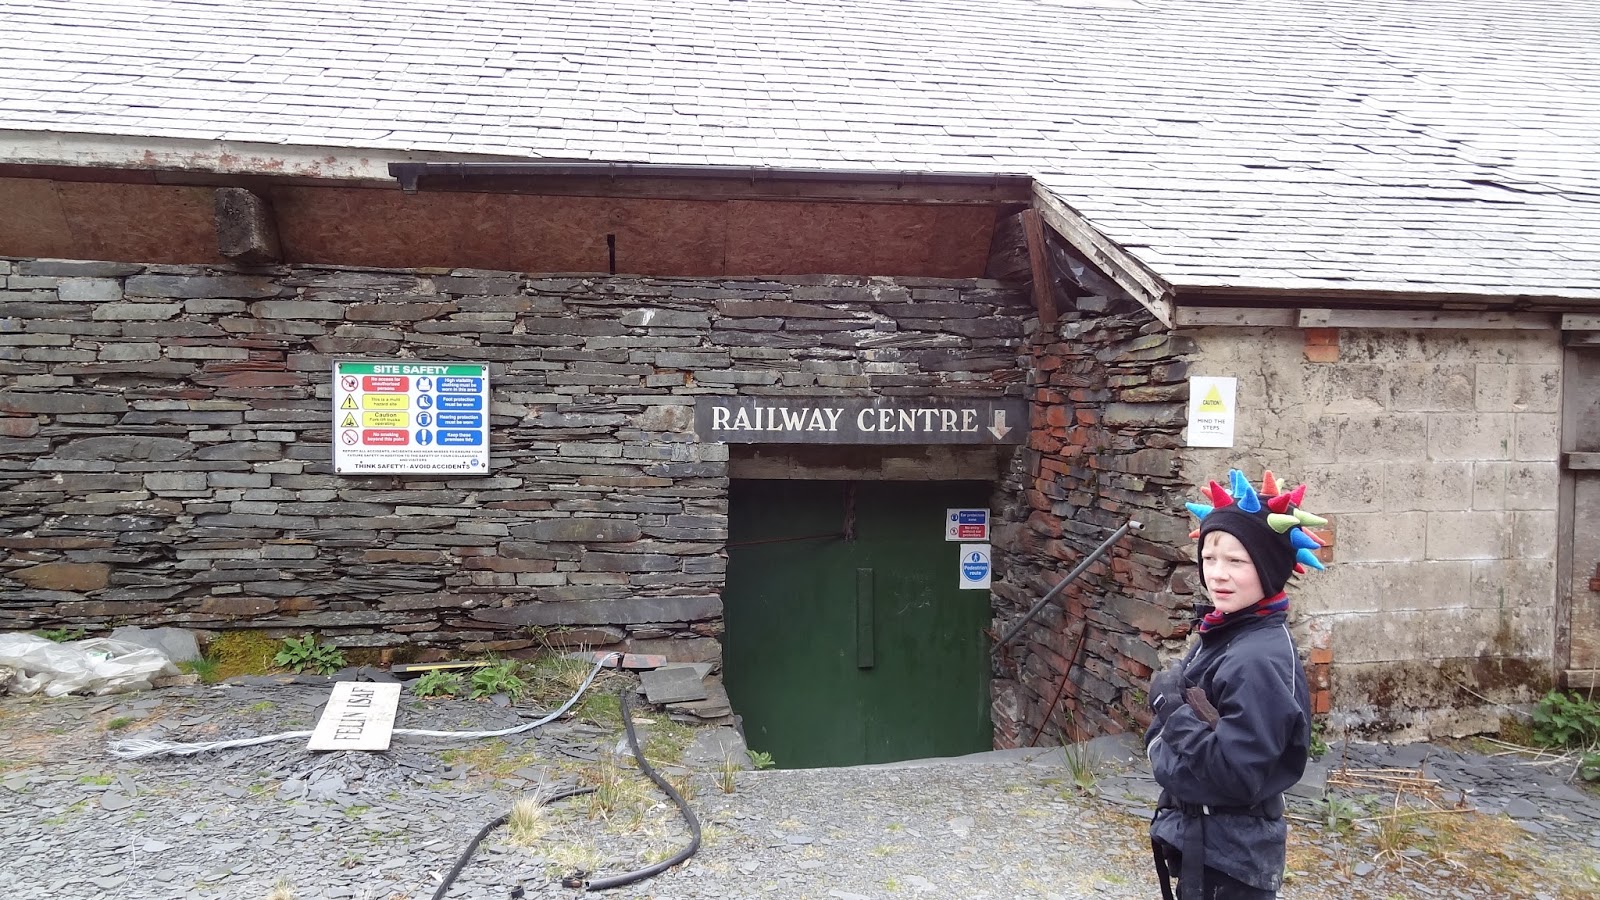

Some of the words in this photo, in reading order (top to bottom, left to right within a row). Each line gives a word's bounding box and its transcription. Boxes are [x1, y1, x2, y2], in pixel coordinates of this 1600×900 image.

[373, 365, 400, 374] SITE
[402, 365, 449, 374] SAFETY
[712, 406, 844, 432] RAILWAY
[857, 408, 978, 432] CENTRE
[346, 687, 374, 707] ISAF
[334, 712, 367, 740] FELIN
